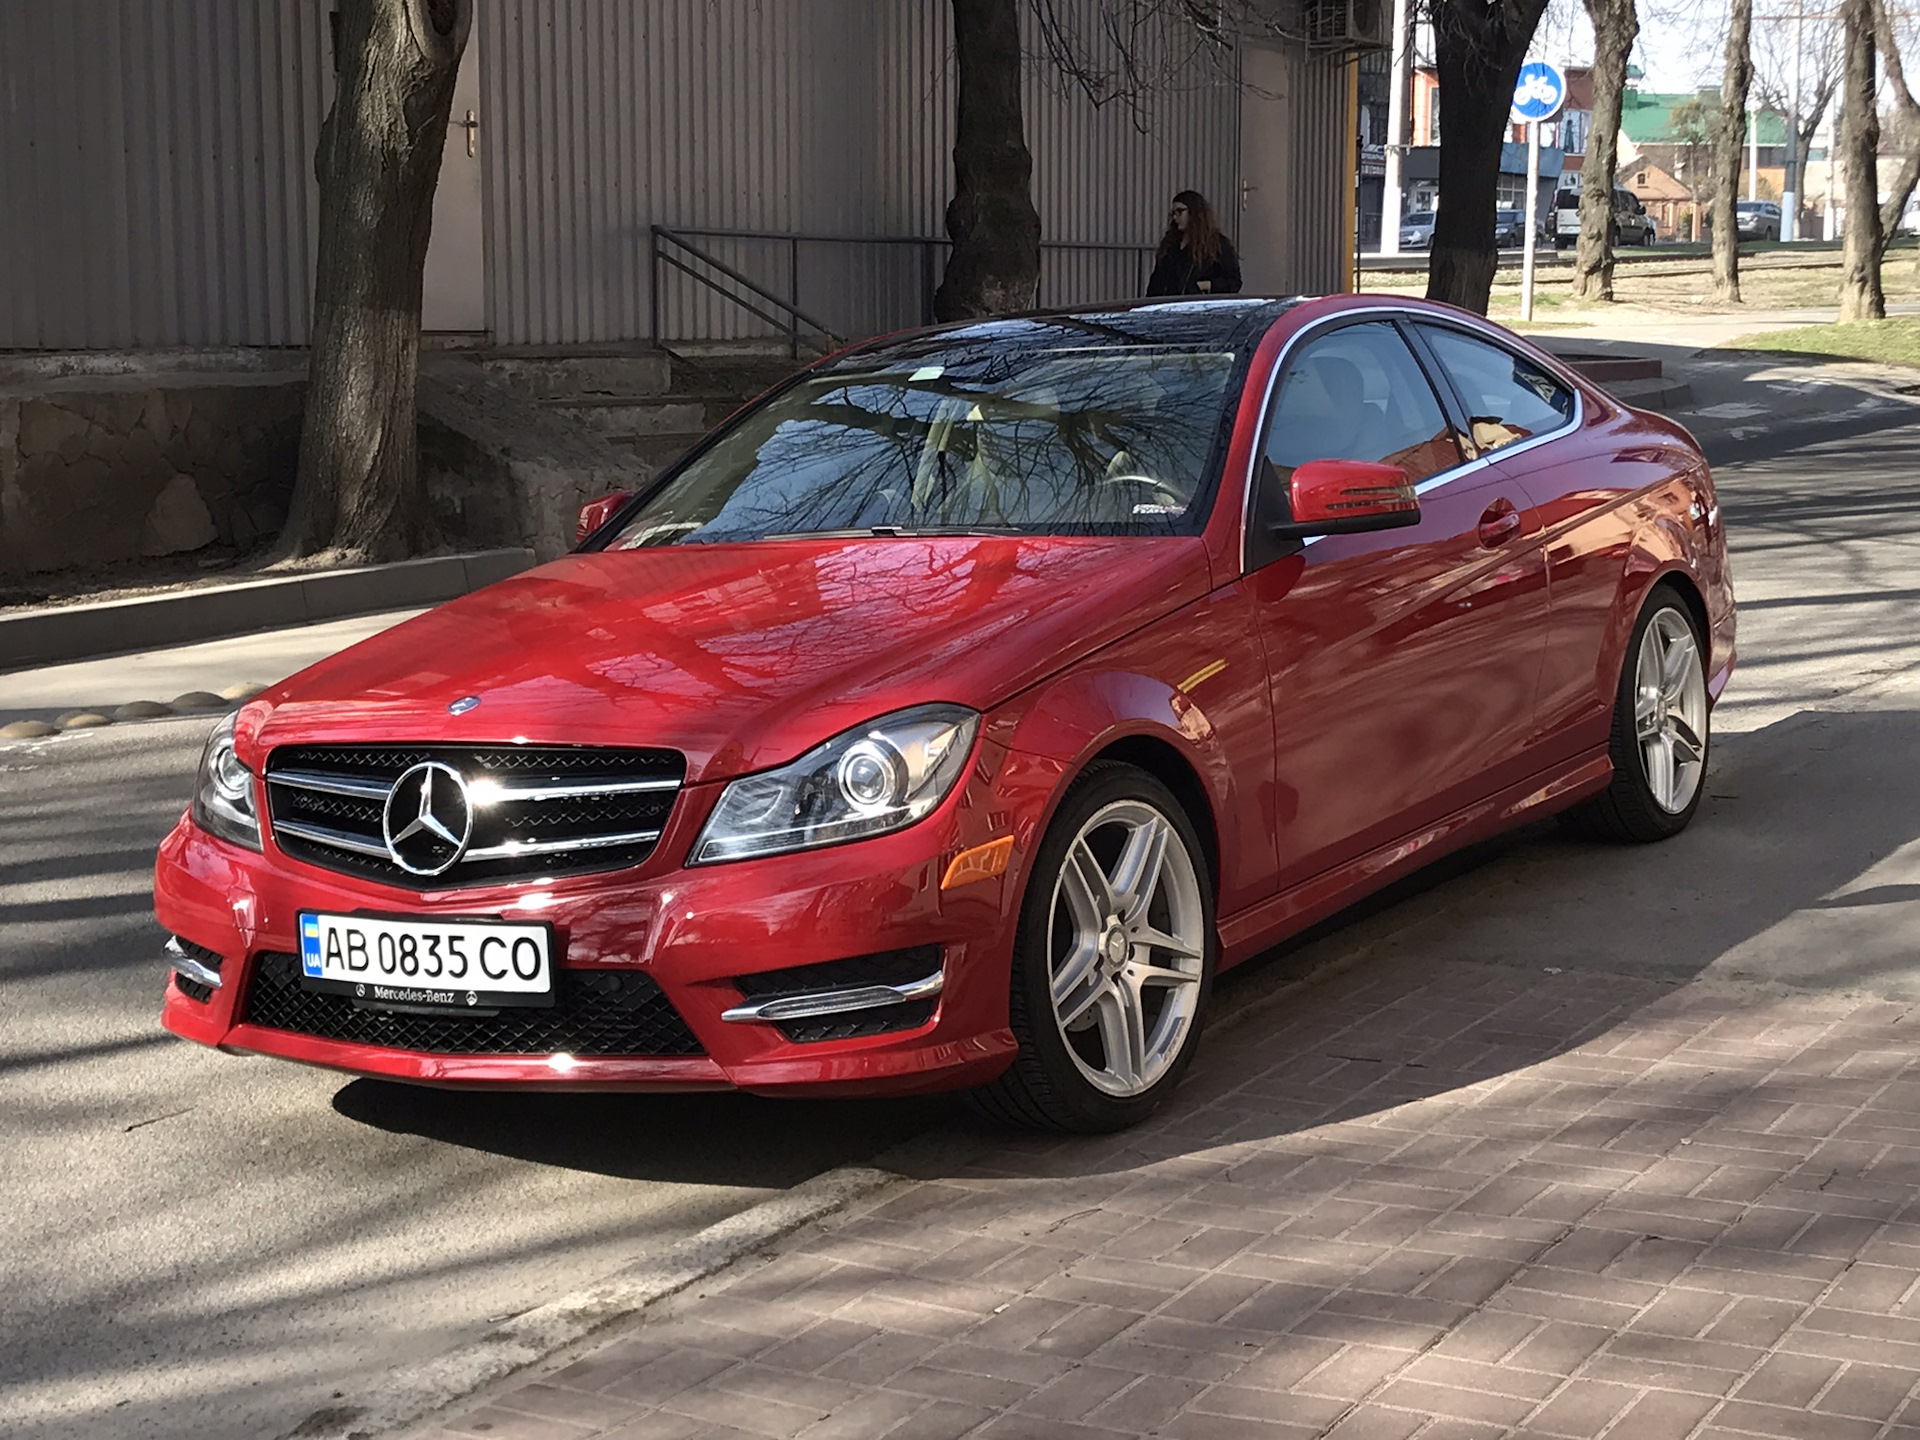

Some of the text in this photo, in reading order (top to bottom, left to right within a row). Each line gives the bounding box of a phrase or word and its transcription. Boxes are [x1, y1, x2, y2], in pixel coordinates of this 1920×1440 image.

[306, 953, 321, 968] UA
[325, 927, 541, 981] AB 0835 CO
[374, 986, 455, 1004] Mercedes-Benz
